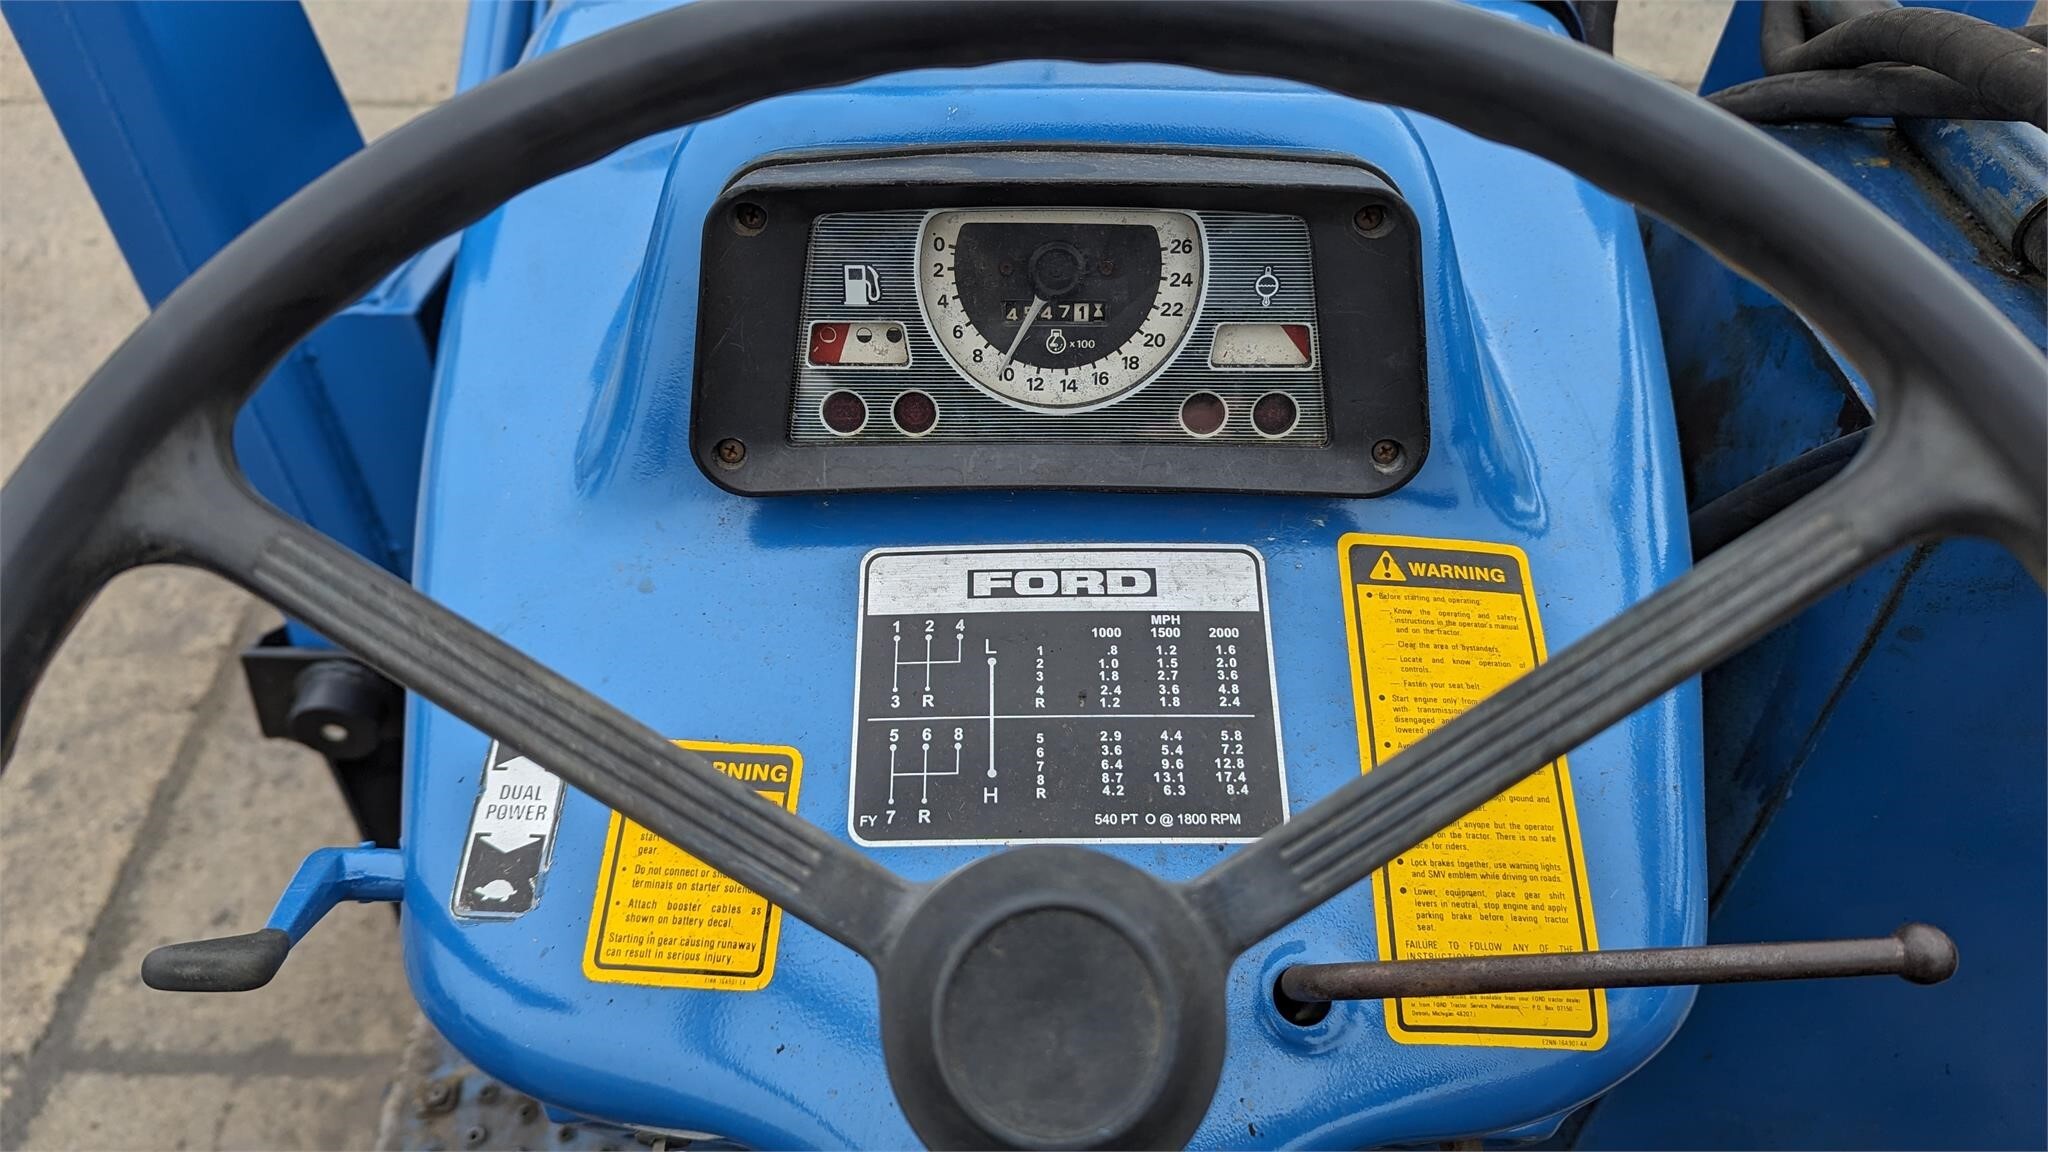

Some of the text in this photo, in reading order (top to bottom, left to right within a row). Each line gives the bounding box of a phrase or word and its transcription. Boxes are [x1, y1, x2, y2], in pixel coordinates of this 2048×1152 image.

[933, 236, 946, 252] 0
[1170, 237, 1193, 255] 26
[933, 262, 944, 278] 2
[1169, 272, 1194, 288] 24
[937, 294, 950, 309] 4
[1160, 302, 1184, 317] 22
[952, 324, 964, 339] 6
[1143, 333, 1166, 348] 20
[972, 348, 984, 363] 8
[1121, 355, 1140, 371] 18
[1026, 377, 1045, 392] 12
[1059, 378, 1079, 393] 14
[1091, 371, 1110, 386] 16
[1408, 561, 1506, 583] WARNING
[972, 570, 1152, 596] FORD
[1150, 614, 1181, 625] MPH
[1439, 610, 1471, 618] operating
[892, 618, 966, 633] 1 2 4
[1091, 627, 1122, 638] 1000
[1150, 627, 1181, 638] 1500
[1208, 627, 1240, 638] 2000
[985, 638, 997, 654] L
[1036, 644, 1236, 656] 1 .8 1.2 1.6
[1036, 657, 1237, 669] 2 1.0 1.5 2.0
[1036, 669, 1239, 682] 3 1.8 2.7 3.6
[1035, 683, 1240, 696] 4 2.4 3.6 4.8
[890, 694, 935, 709] 3 R
[1035, 696, 1241, 708] R 1.2 1.8 2.4
[1414, 696, 1438, 704] engine
[889, 727, 964, 742] 5 6 8
[1036, 730, 1243, 744] 5 2.9 4.4 5.8
[1036, 743, 1244, 758] 6 3.6 5.4 7.2
[712, 761, 788, 783] RNING
[1036, 757, 1245, 772] 7 6.4 9.6 12.8
[1036, 771, 1247, 785] 8 8.7 13.1 17.4
[499, 784, 542, 800] DUAL
[983, 787, 998, 804] H
[1036, 783, 1249, 799] R 4.2 6.3 8.4
[486, 804, 547, 821] POWER
[859, 809, 931, 827] FY 7 R
[1094, 813, 1241, 828] 540 PT O @ 1800 RPM
[634, 864, 646, 875] Do
[648, 866, 662, 875] not
[664, 867, 698, 877] connect
[1411, 859, 1427, 867] Lock
[1430, 859, 1454, 867] brakes
[1510, 863, 1538, 871] warning
[1412, 870, 1425, 878] and
[1448, 871, 1477, 879] emblem
[1502, 873, 1527, 882] driving
[632, 879, 673, 890] terminals
[677, 882, 687, 890] on
[691, 882, 720, 892] starter
[628, 899, 761, 915] Attach booster cables as
[625, 913, 654, 924] shown
[658, 915, 668, 924] on
[672, 915, 703, 928] battery
[1416, 912, 1444, 921] parking
[1480, 913, 1504, 921] before
[1511, 914, 1538, 924] leaving
[1545, 916, 1569, 924] tractor
[609, 932, 756, 952] Starting in gear causing runaway
[1406, 940, 1438, 949] FAILURE
[1449, 941, 1459, 950] TO
[1470, 942, 1502, 951] FOLLOW
[1513, 944, 1529, 952] ANY
[1539, 944, 1549, 952] OF
[606, 948, 621, 956] can
[625, 948, 651, 957] result
[655, 949, 663, 958] in
[667, 951, 700, 961] serious
